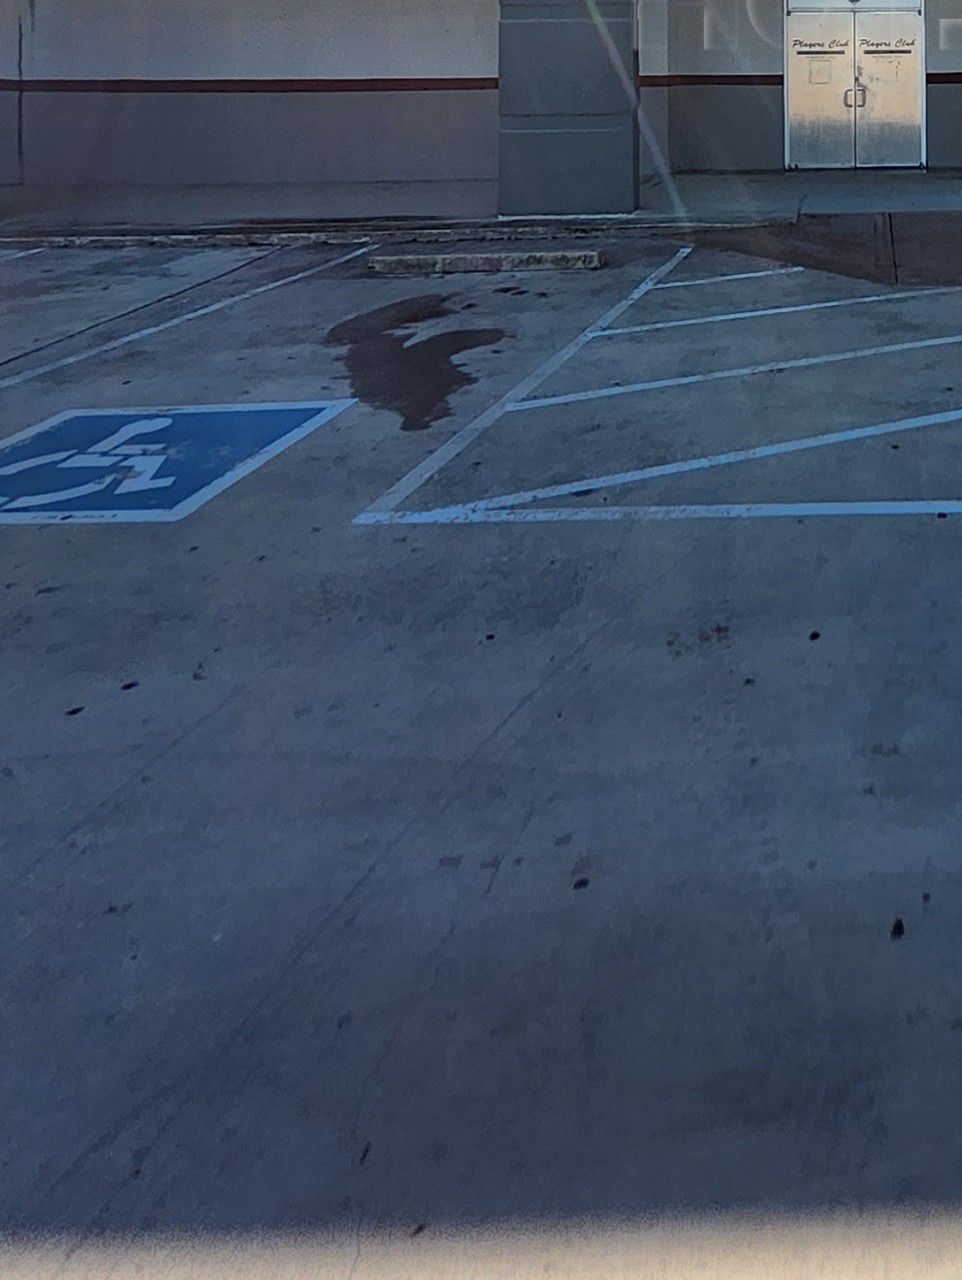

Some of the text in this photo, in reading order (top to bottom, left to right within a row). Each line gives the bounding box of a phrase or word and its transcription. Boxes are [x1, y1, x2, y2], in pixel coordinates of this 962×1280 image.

[792, 39, 849, 49] Players Club
[859, 38, 916, 48] Players Club
